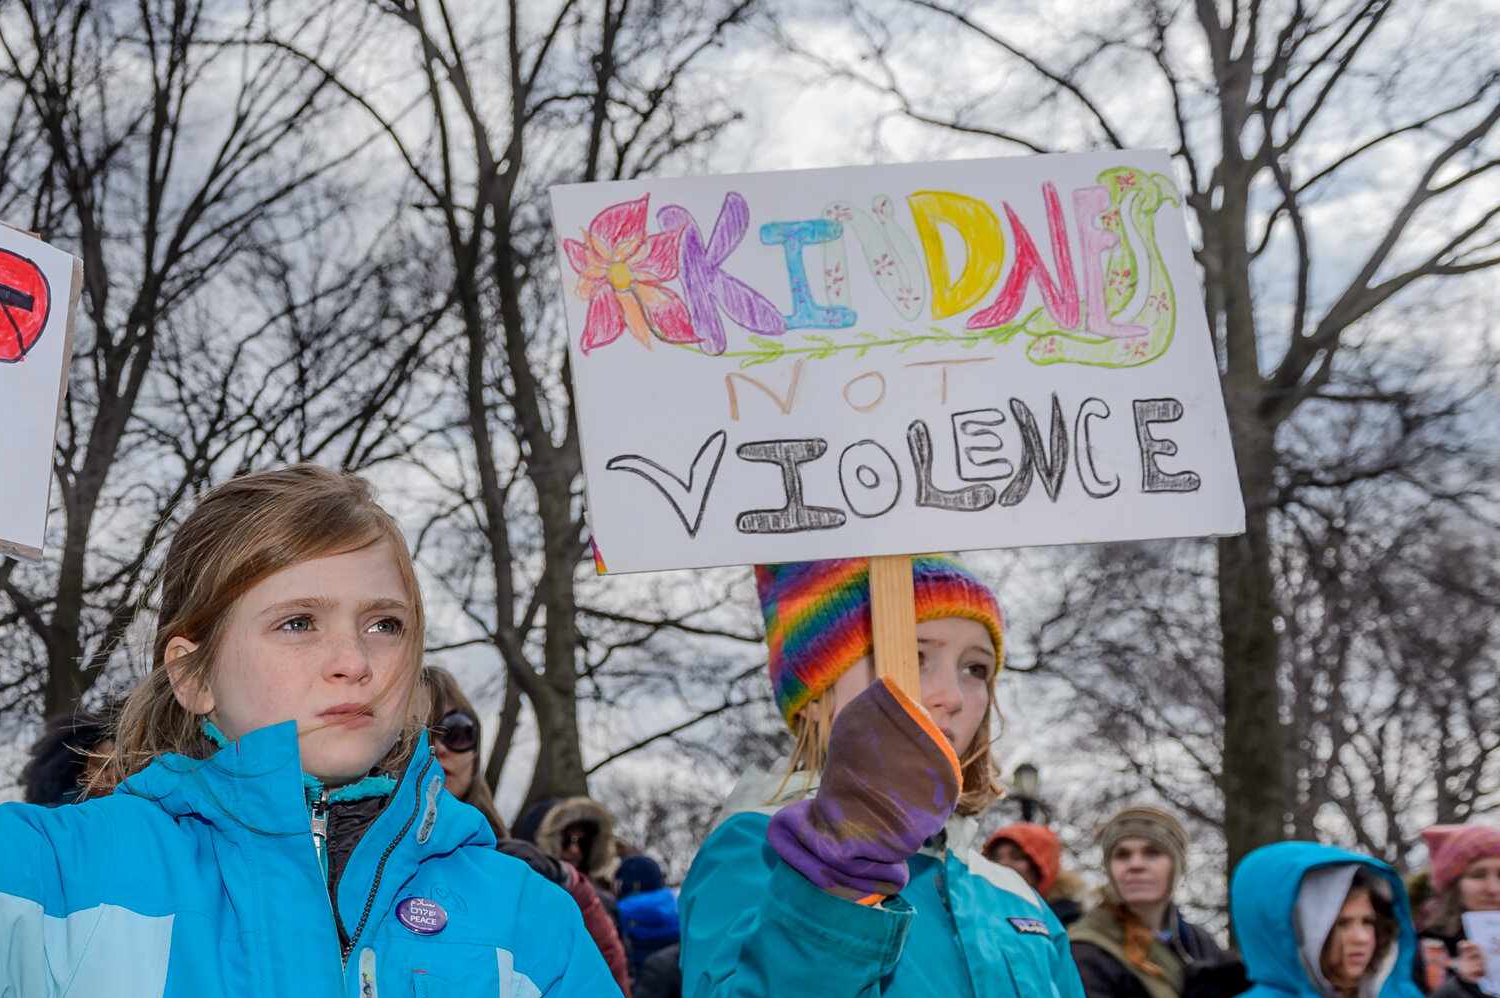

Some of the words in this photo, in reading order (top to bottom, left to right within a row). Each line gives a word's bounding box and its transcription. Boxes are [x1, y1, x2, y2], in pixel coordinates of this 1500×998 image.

[724, 357, 995, 421] NOT
[606, 391, 1201, 538] VIOLENCE
[410, 898, 435, 907] سلام
[410, 907, 436, 917] שלום
[410, 915, 437, 925] PEACE
